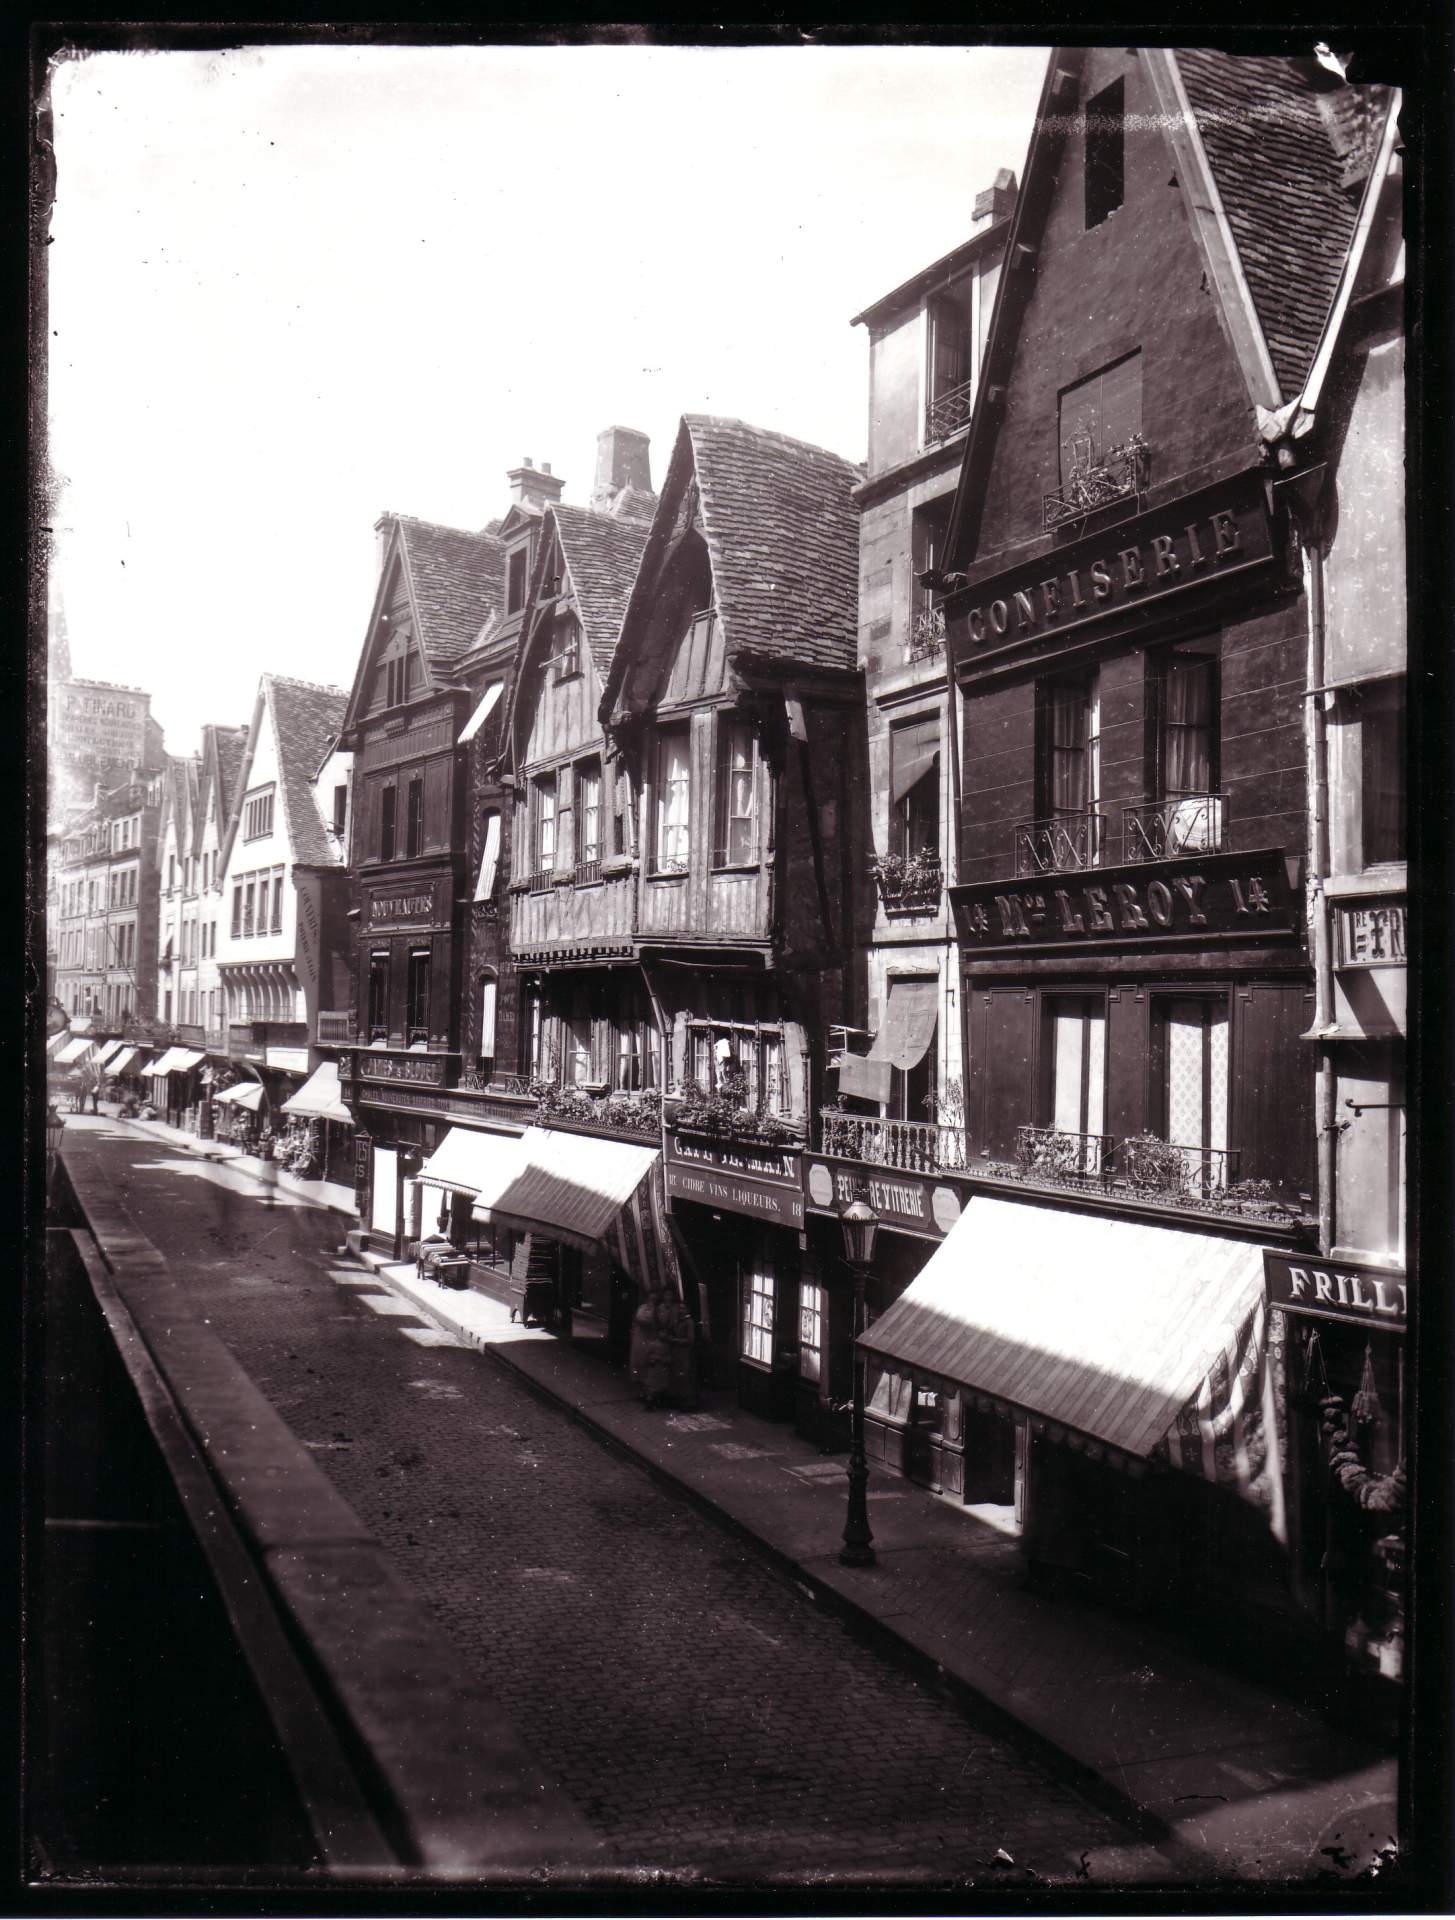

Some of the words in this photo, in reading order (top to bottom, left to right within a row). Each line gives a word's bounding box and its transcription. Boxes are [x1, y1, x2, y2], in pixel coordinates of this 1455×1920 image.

[967, 509, 1240, 642] CONFISERIE
[1055, 875, 1208, 932] LEROY
[1228, 877, 1270, 913] 14
[682, 1177, 706, 1198] CIDRE
[709, 1183, 728, 1199] VINS
[792, 1202, 802, 1217] 18
[881, 1183, 925, 1218] VITRERIE
